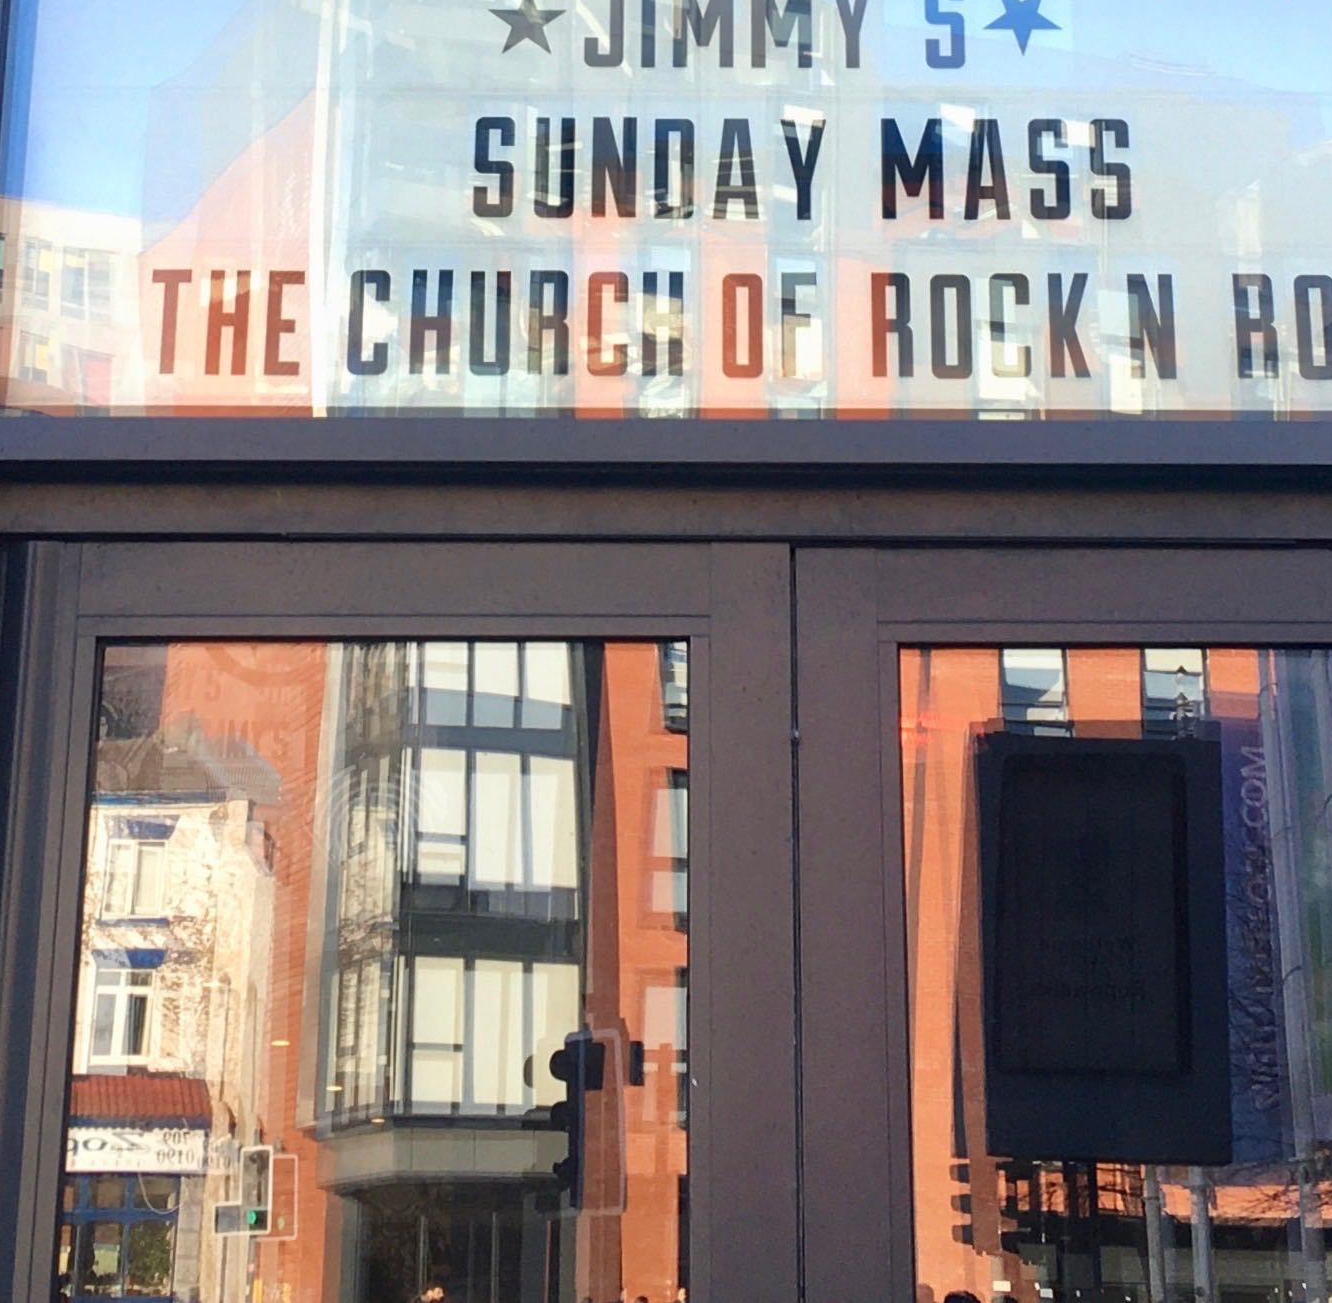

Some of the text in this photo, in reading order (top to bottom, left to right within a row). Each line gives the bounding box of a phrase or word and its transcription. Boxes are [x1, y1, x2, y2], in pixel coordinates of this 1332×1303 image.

[473, 116, 1132, 221] SUNDAY MASS
[152, 269, 305, 376] THE
[347, 269, 685, 377] CHURCH
[722, 273, 818, 379] OF
[870, 273, 1092, 380] ROCK
[1126, 274, 1178, 380] N
